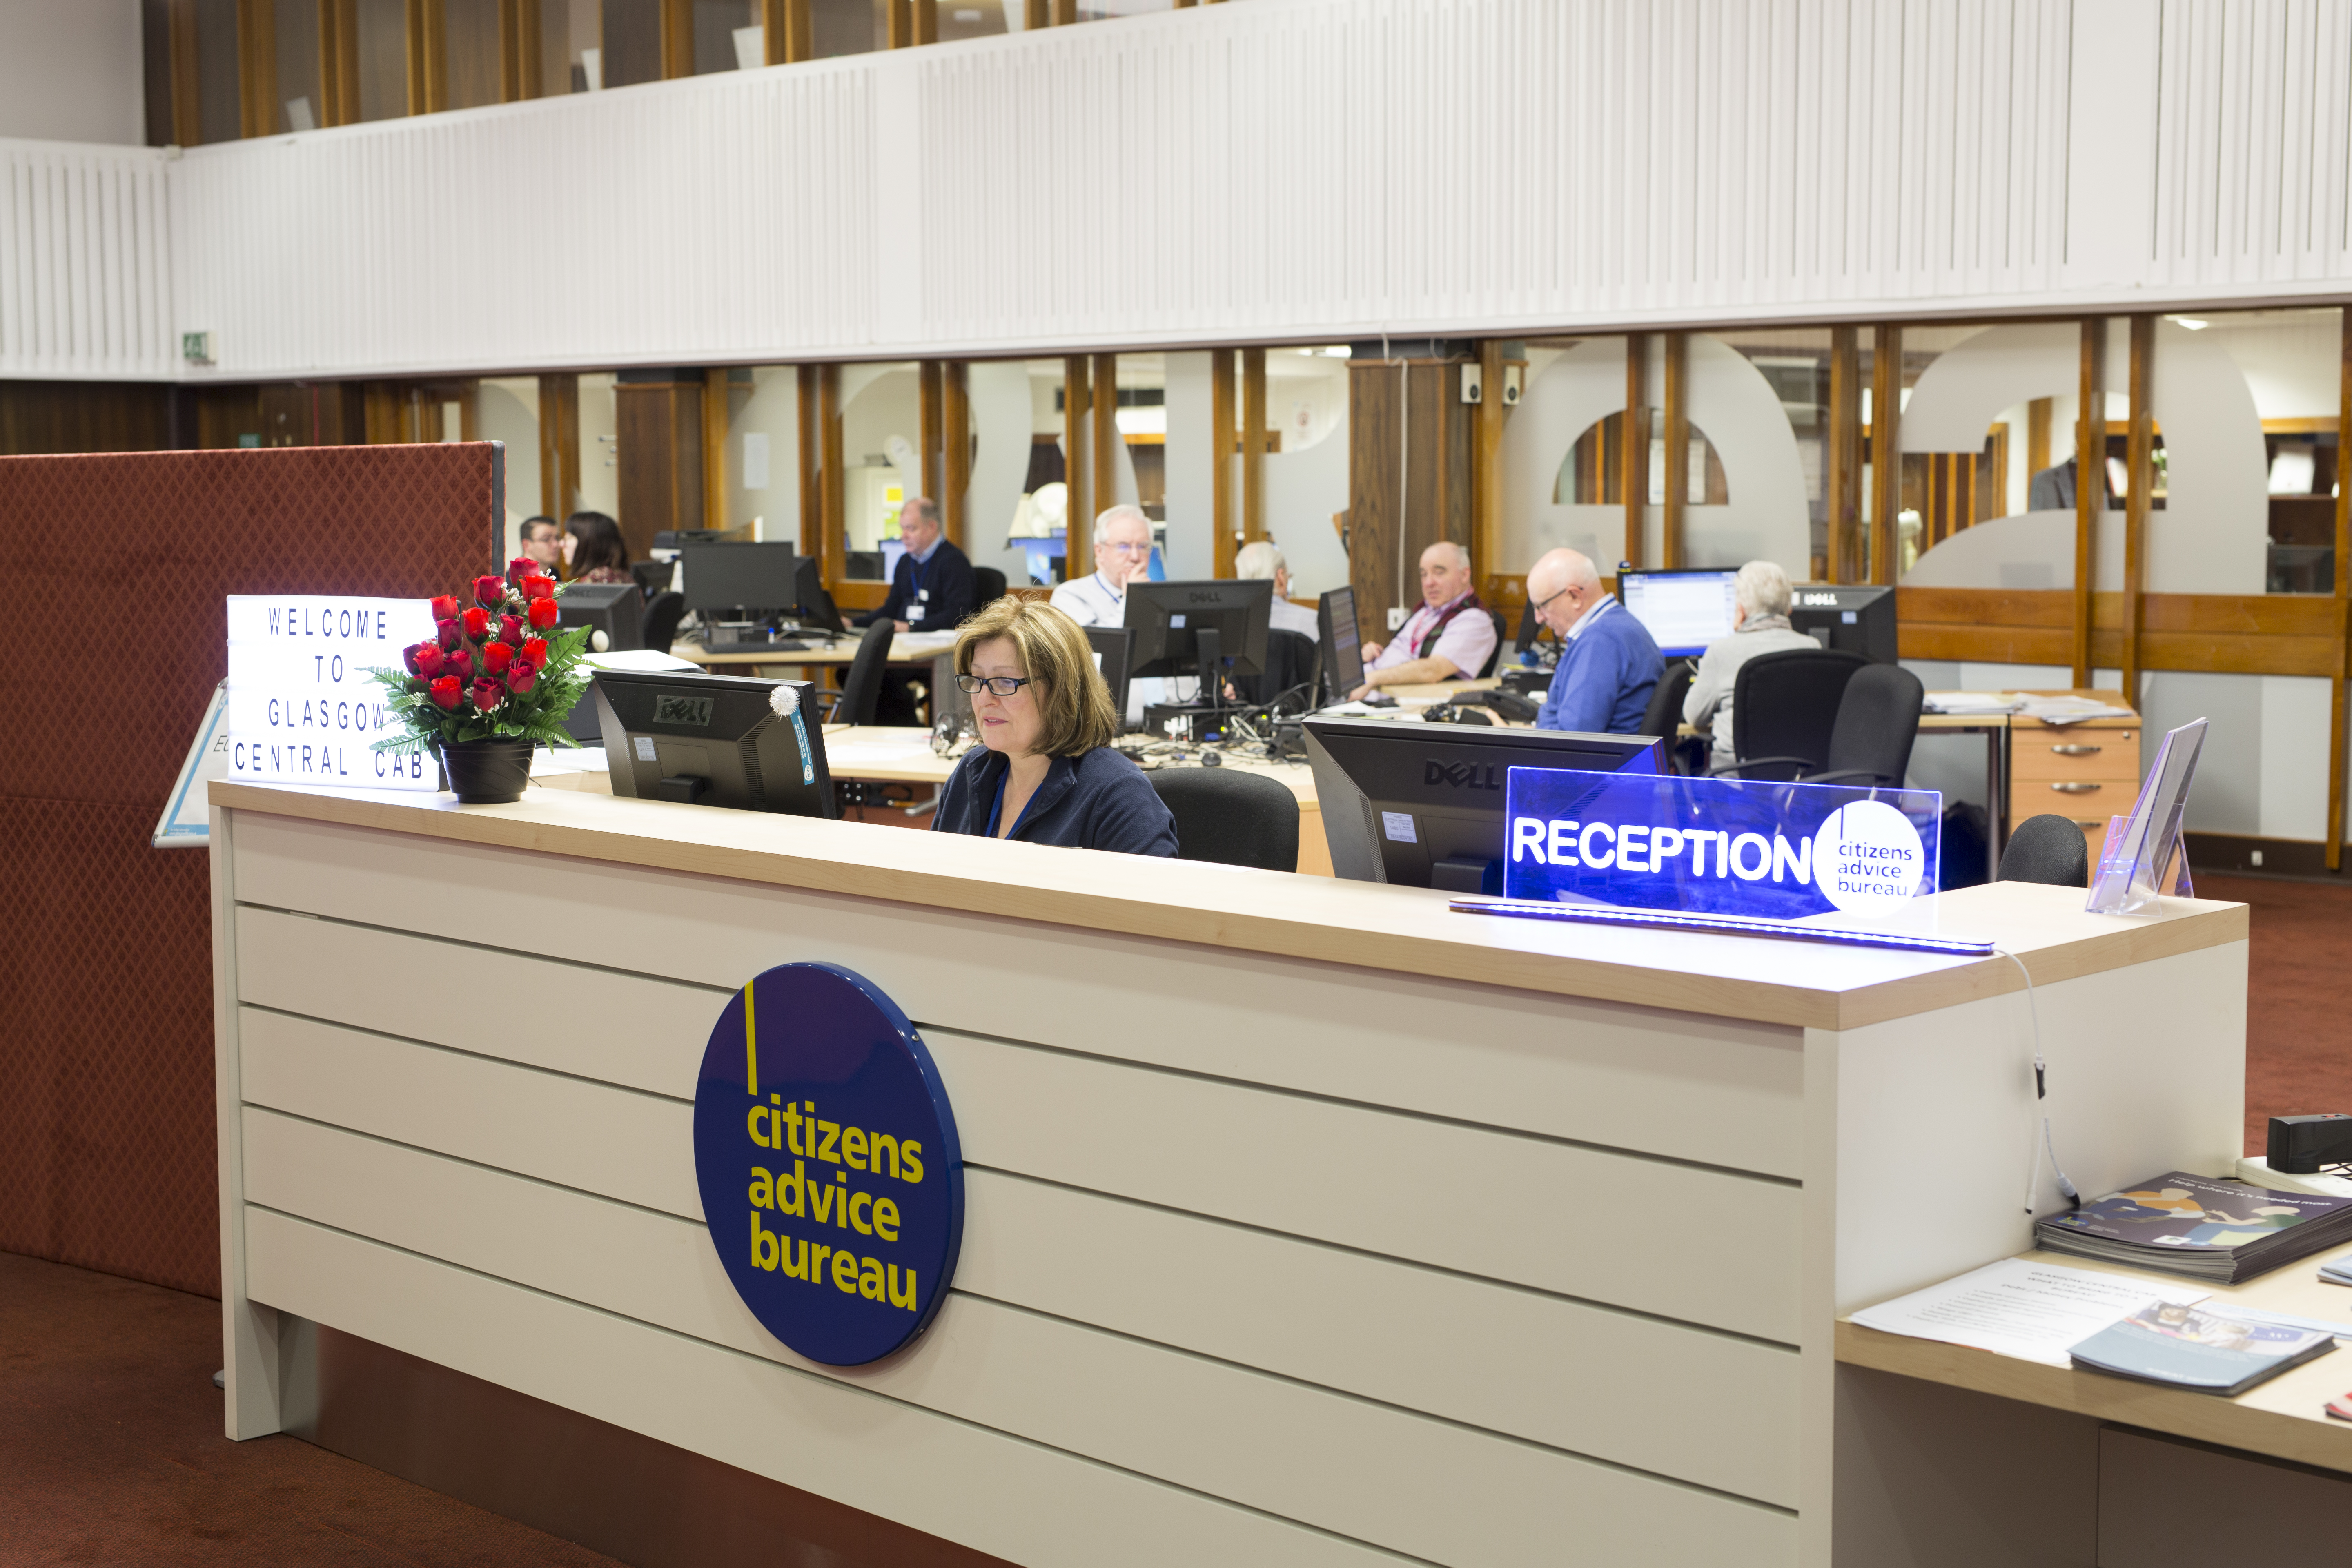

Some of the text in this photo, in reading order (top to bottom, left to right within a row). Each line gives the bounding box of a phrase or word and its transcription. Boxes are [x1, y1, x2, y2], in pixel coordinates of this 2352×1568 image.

[1189, 592, 1221, 603] DELL
[1804, 593, 1838, 606] DELL
[269, 608, 386, 639] WELCOME
[315, 655, 343, 683] TO
[269, 698, 384, 731] GLASGOW
[660, 698, 707, 722] DELL
[235, 742, 421, 779] CENTRAL CAB
[1424, 758, 1500, 791] DELL
[1513, 817, 1812, 885] RECEPTION
[1839, 841, 1912, 860] citizens
[1838, 860, 1901, 878] advice
[1838, 877, 1907, 896] bureau
[747, 1093, 924, 1184] citizens
[748, 1159, 900, 1242] advice
[2169, 1179, 2196, 1187] Help
[2198, 1185, 2234, 1194] where
[2255, 1196, 2301, 1204] needed
[751, 1210, 916, 1312] bureau
